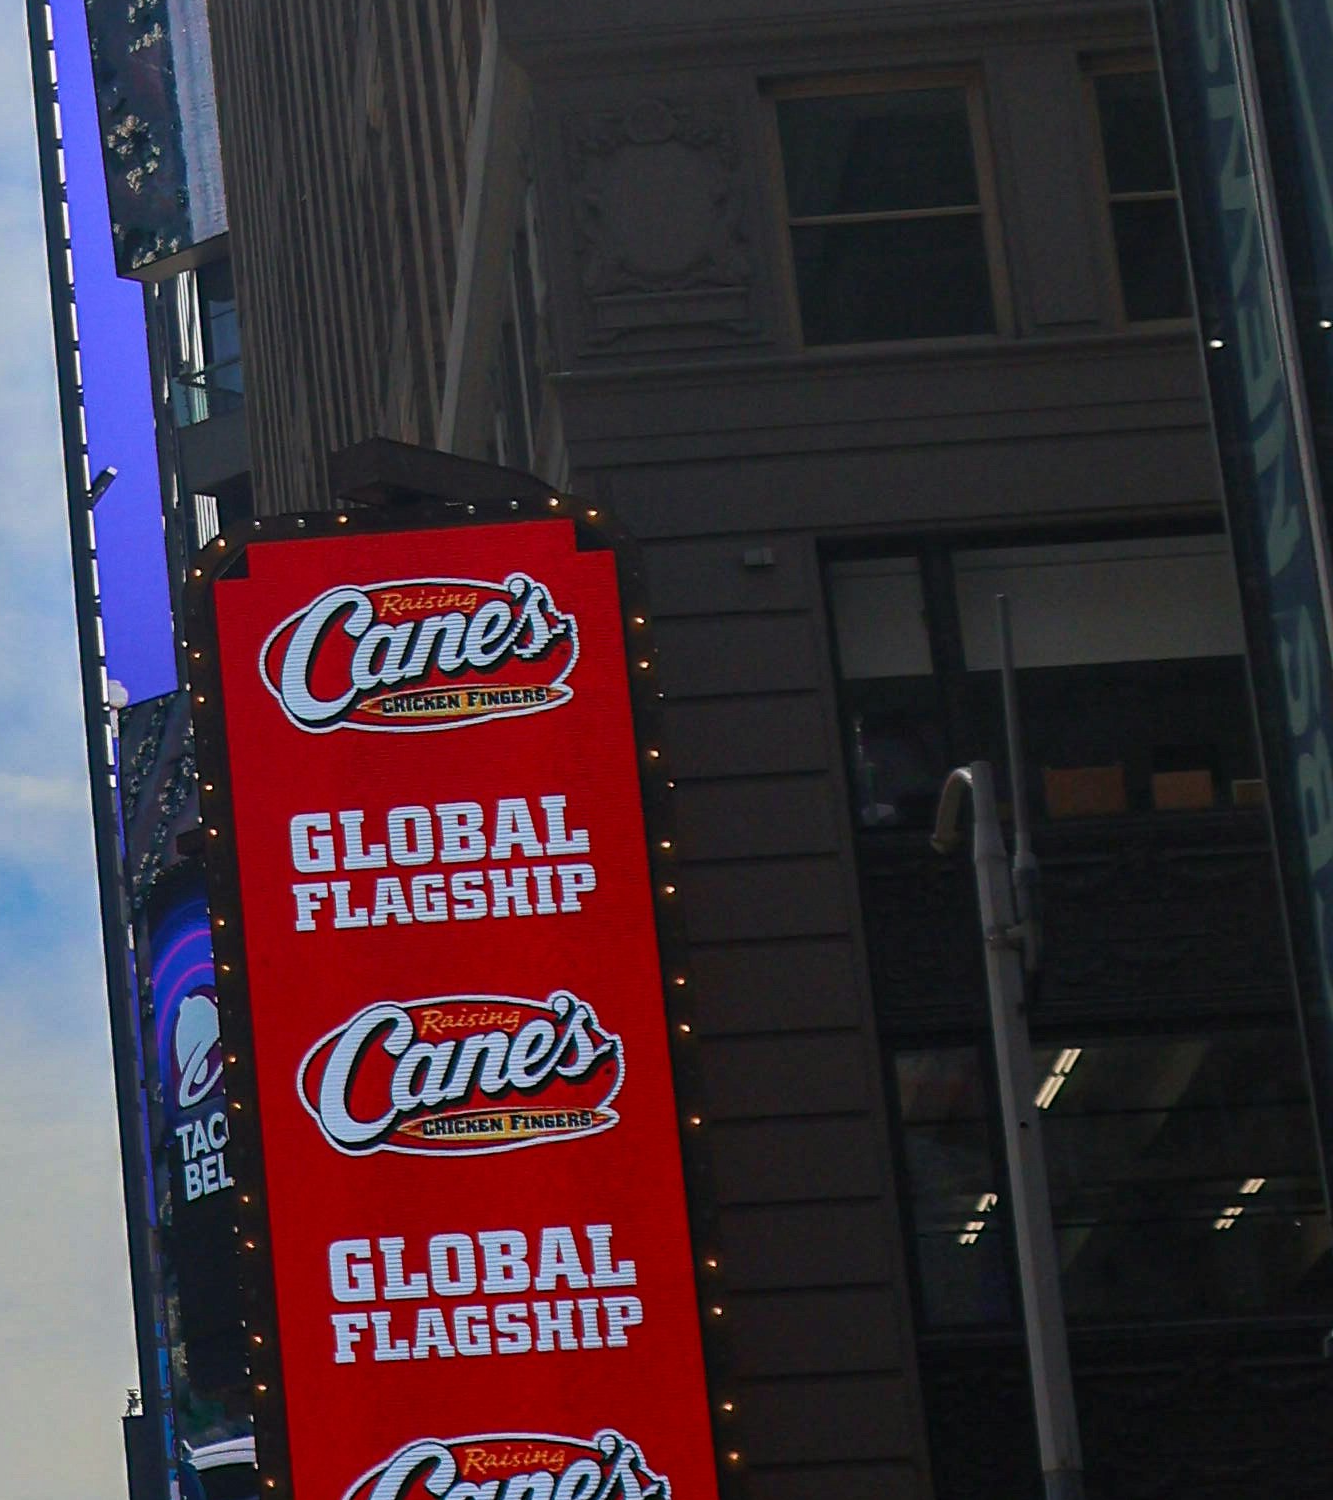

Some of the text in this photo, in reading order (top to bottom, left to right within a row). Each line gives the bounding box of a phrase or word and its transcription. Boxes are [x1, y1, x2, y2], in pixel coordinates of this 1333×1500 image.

[380, 588, 479, 616] Raising
[281, 577, 566, 721] Cane's
[381, 687, 548, 715] CHICKEN FINGERS
[289, 794, 591, 873] GLOBAL
[292, 863, 597, 932] FLAGSHIP
[420, 1006, 521, 1036] Raising
[320, 994, 613, 1143] Cane's
[175, 1113, 229, 1162] TAC
[422, 1110, 593, 1137] CHICKEN FINGERS
[183, 1153, 233, 1202] BEL
[329, 1224, 637, 1303] GLOBAL
[331, 1295, 643, 1364] FLAGSHIP
[464, 1445, 566, 1476] Raising
